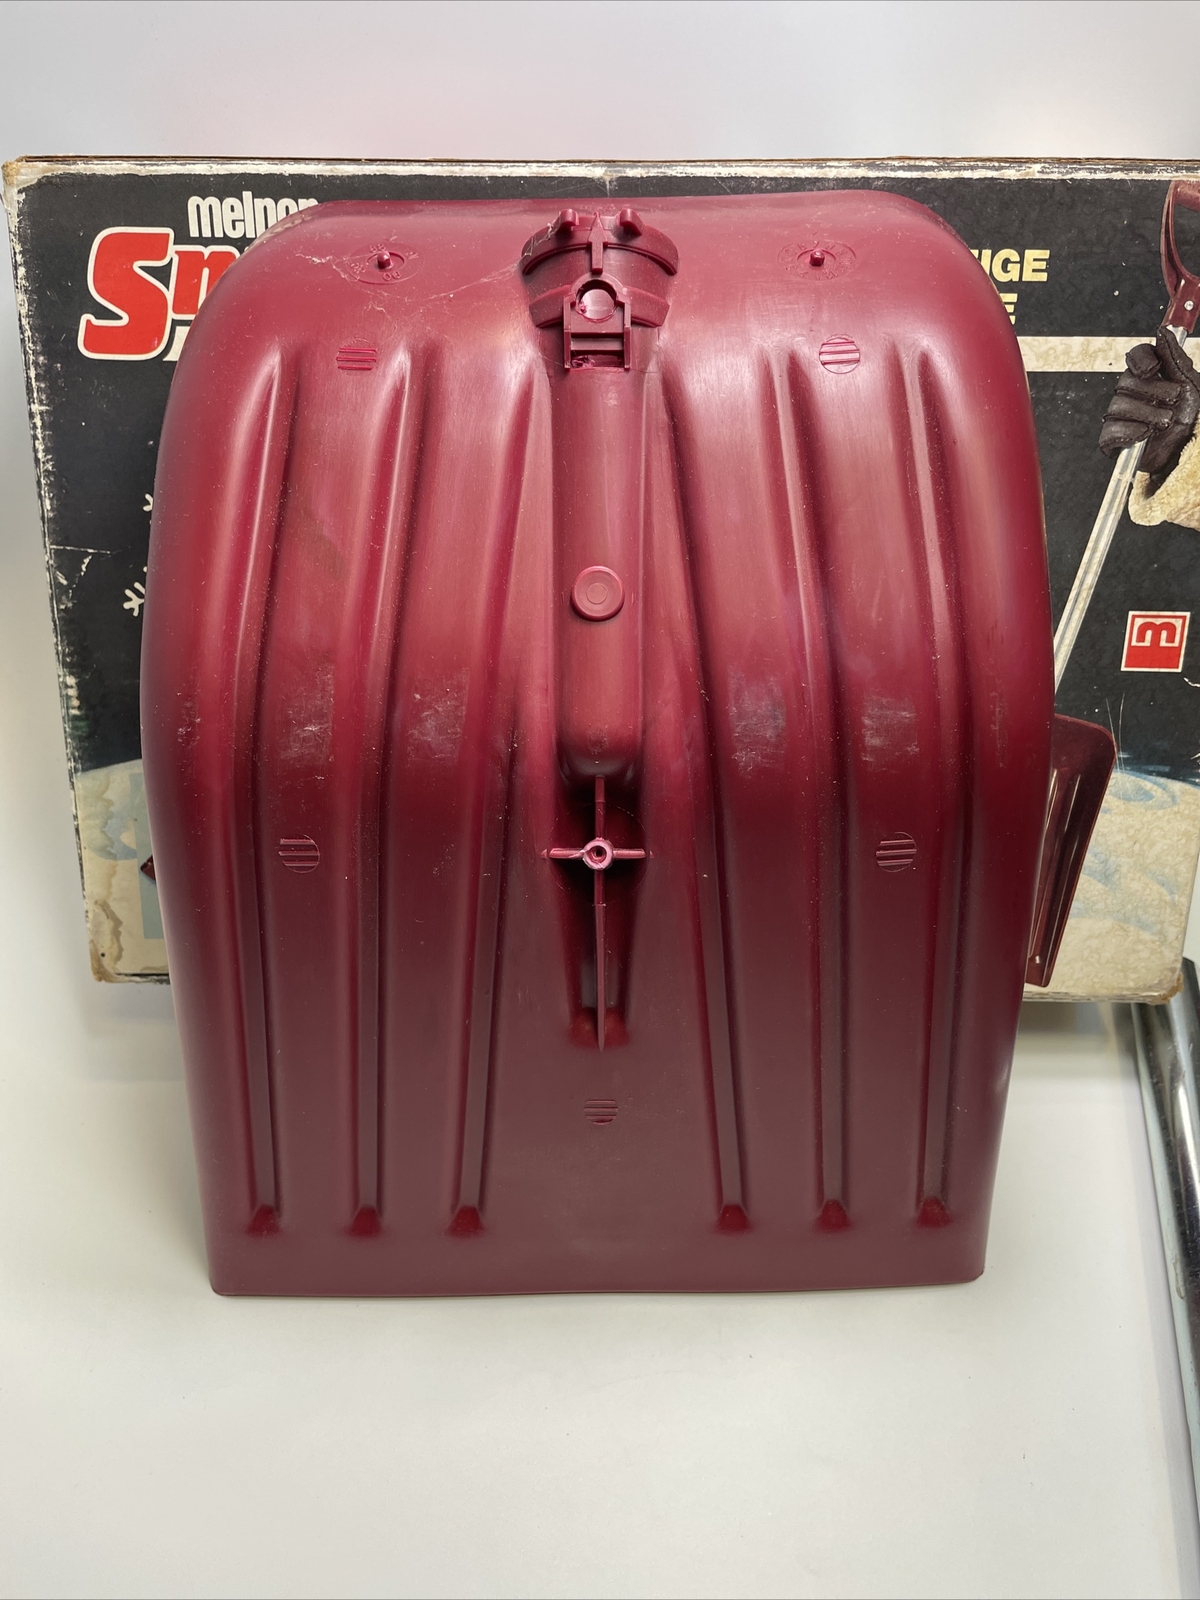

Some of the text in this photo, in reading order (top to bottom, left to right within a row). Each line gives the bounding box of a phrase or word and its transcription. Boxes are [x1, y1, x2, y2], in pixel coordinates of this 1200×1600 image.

[187, 191, 319, 238] meln
[969, 248, 1050, 282] IGE
[77, 226, 249, 361] Sn
